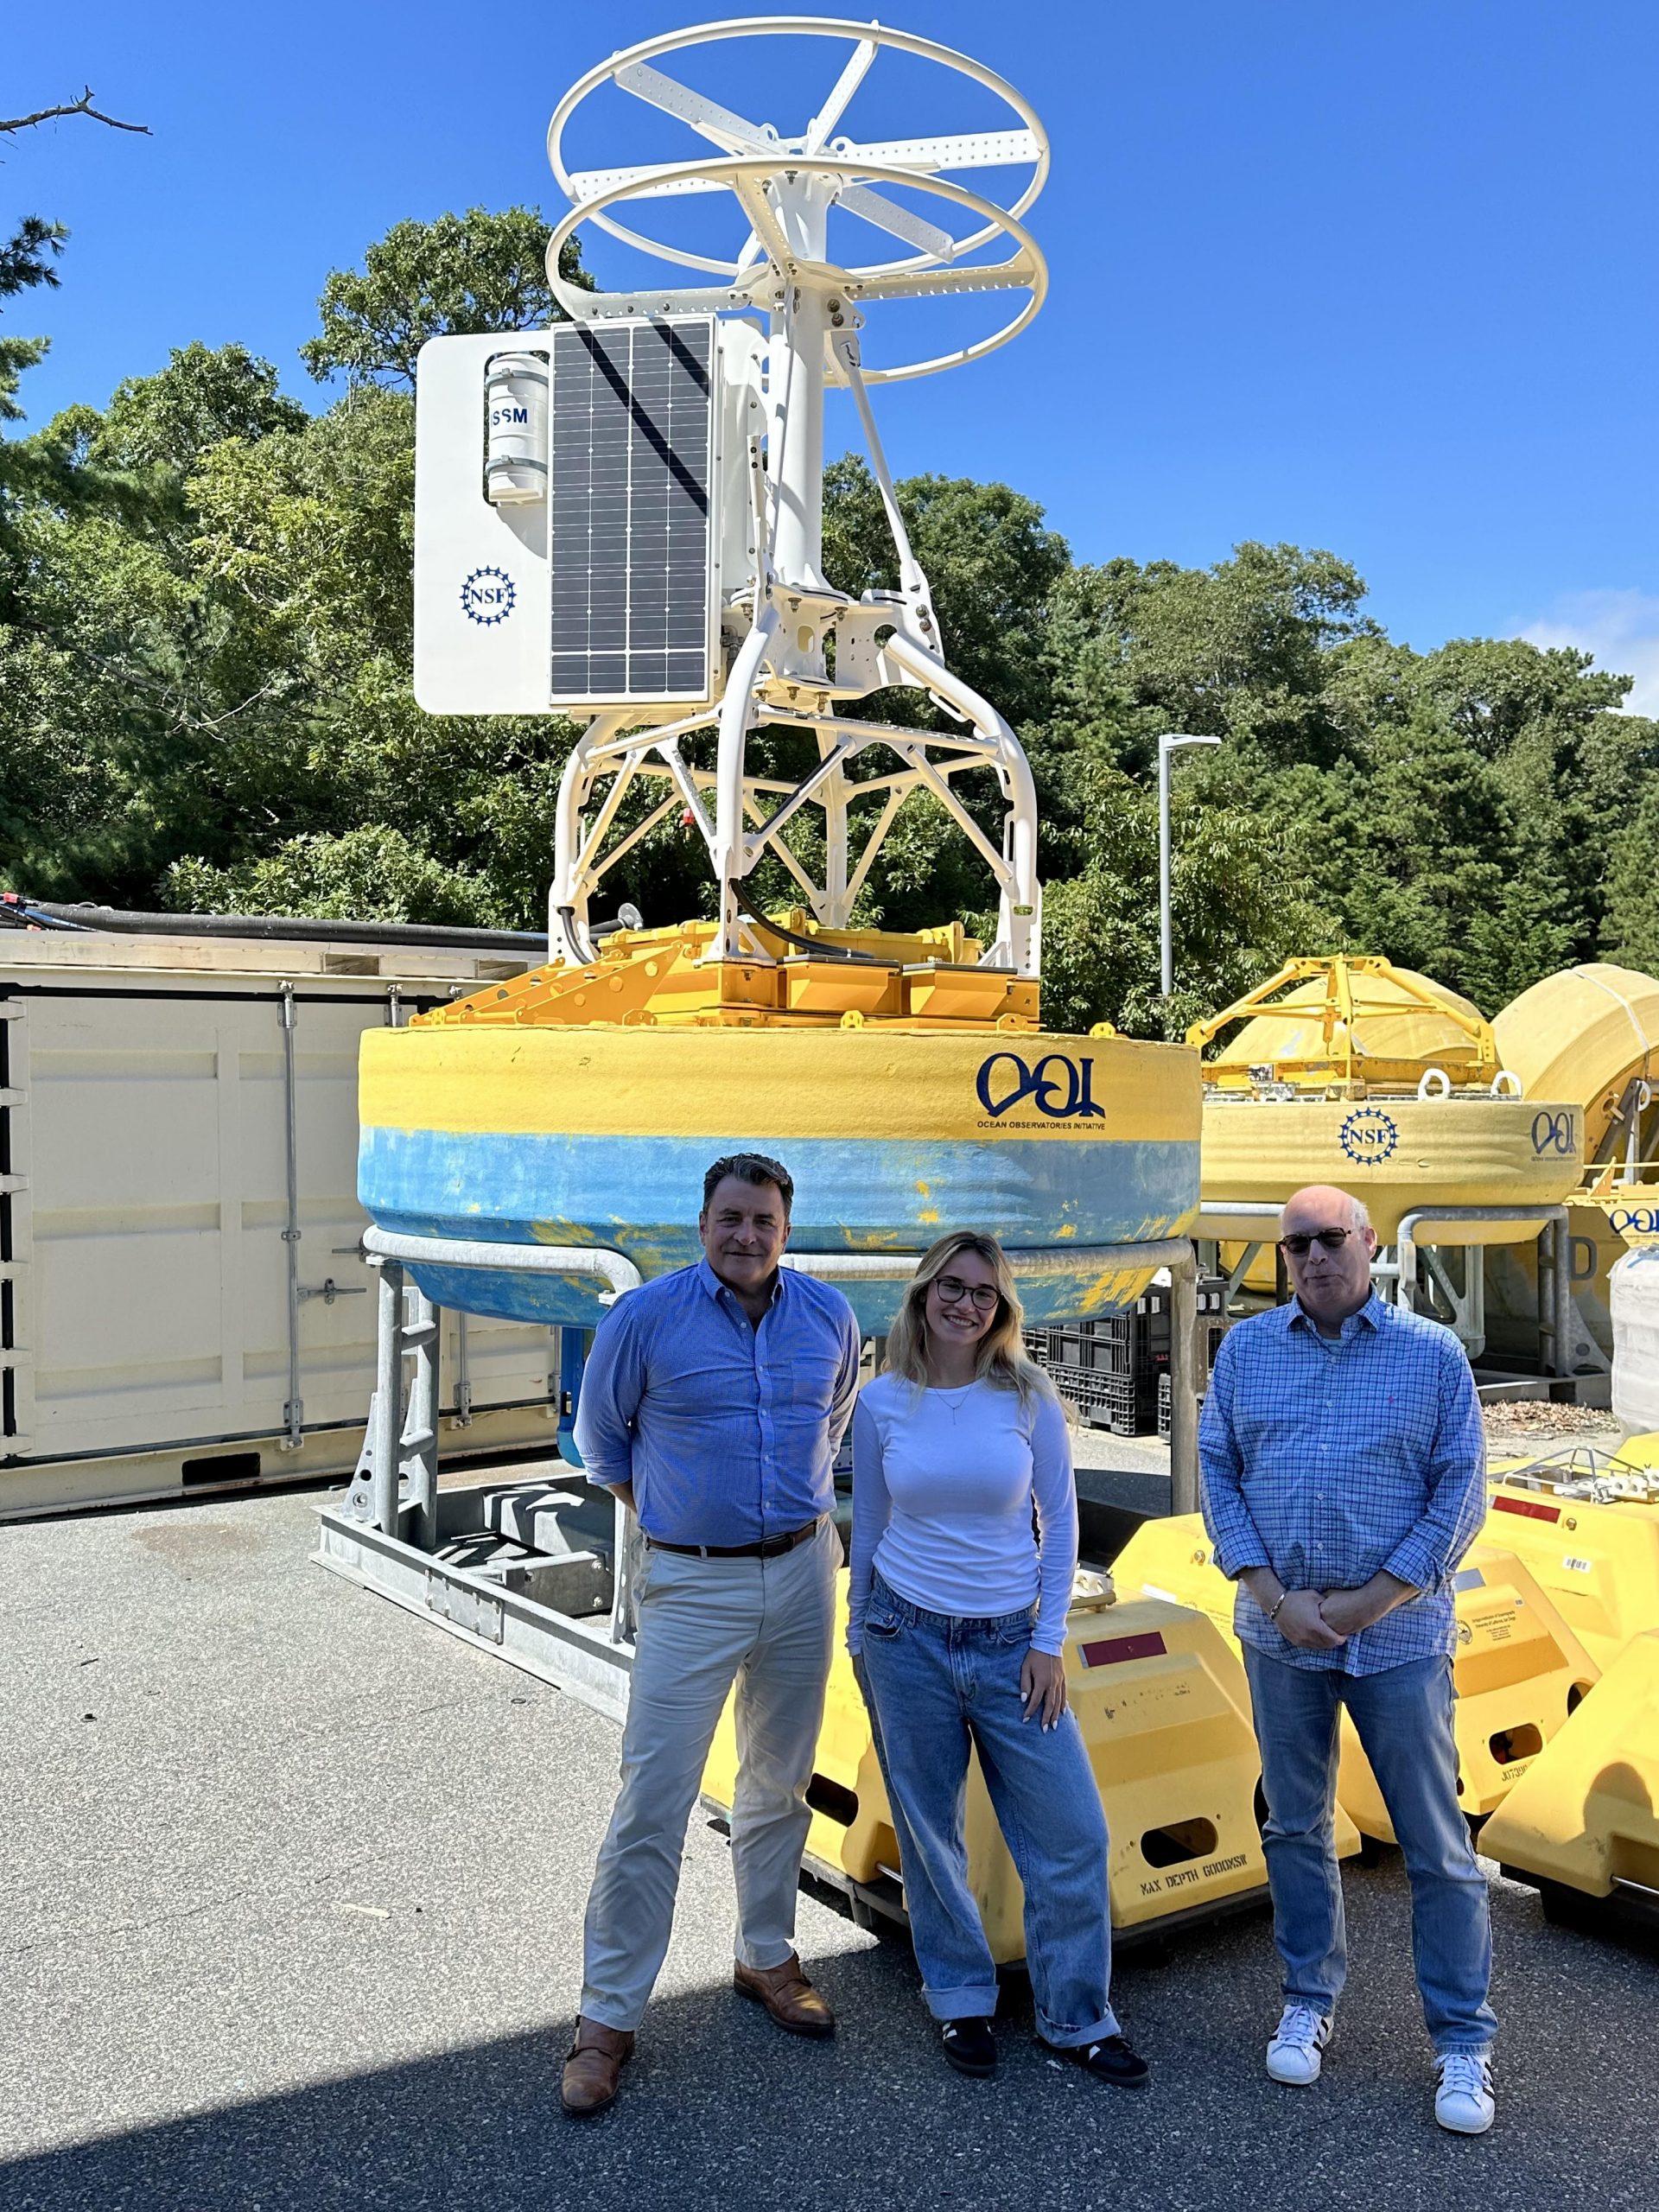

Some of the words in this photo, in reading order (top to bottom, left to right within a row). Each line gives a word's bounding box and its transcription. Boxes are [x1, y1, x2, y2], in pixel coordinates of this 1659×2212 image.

[470, 588, 507, 605] NSF
[1350, 1128, 1389, 1145] NSF
[1140, 1879, 1162, 1896] MAX
[1165, 1868, 1199, 1888] DEPTH
